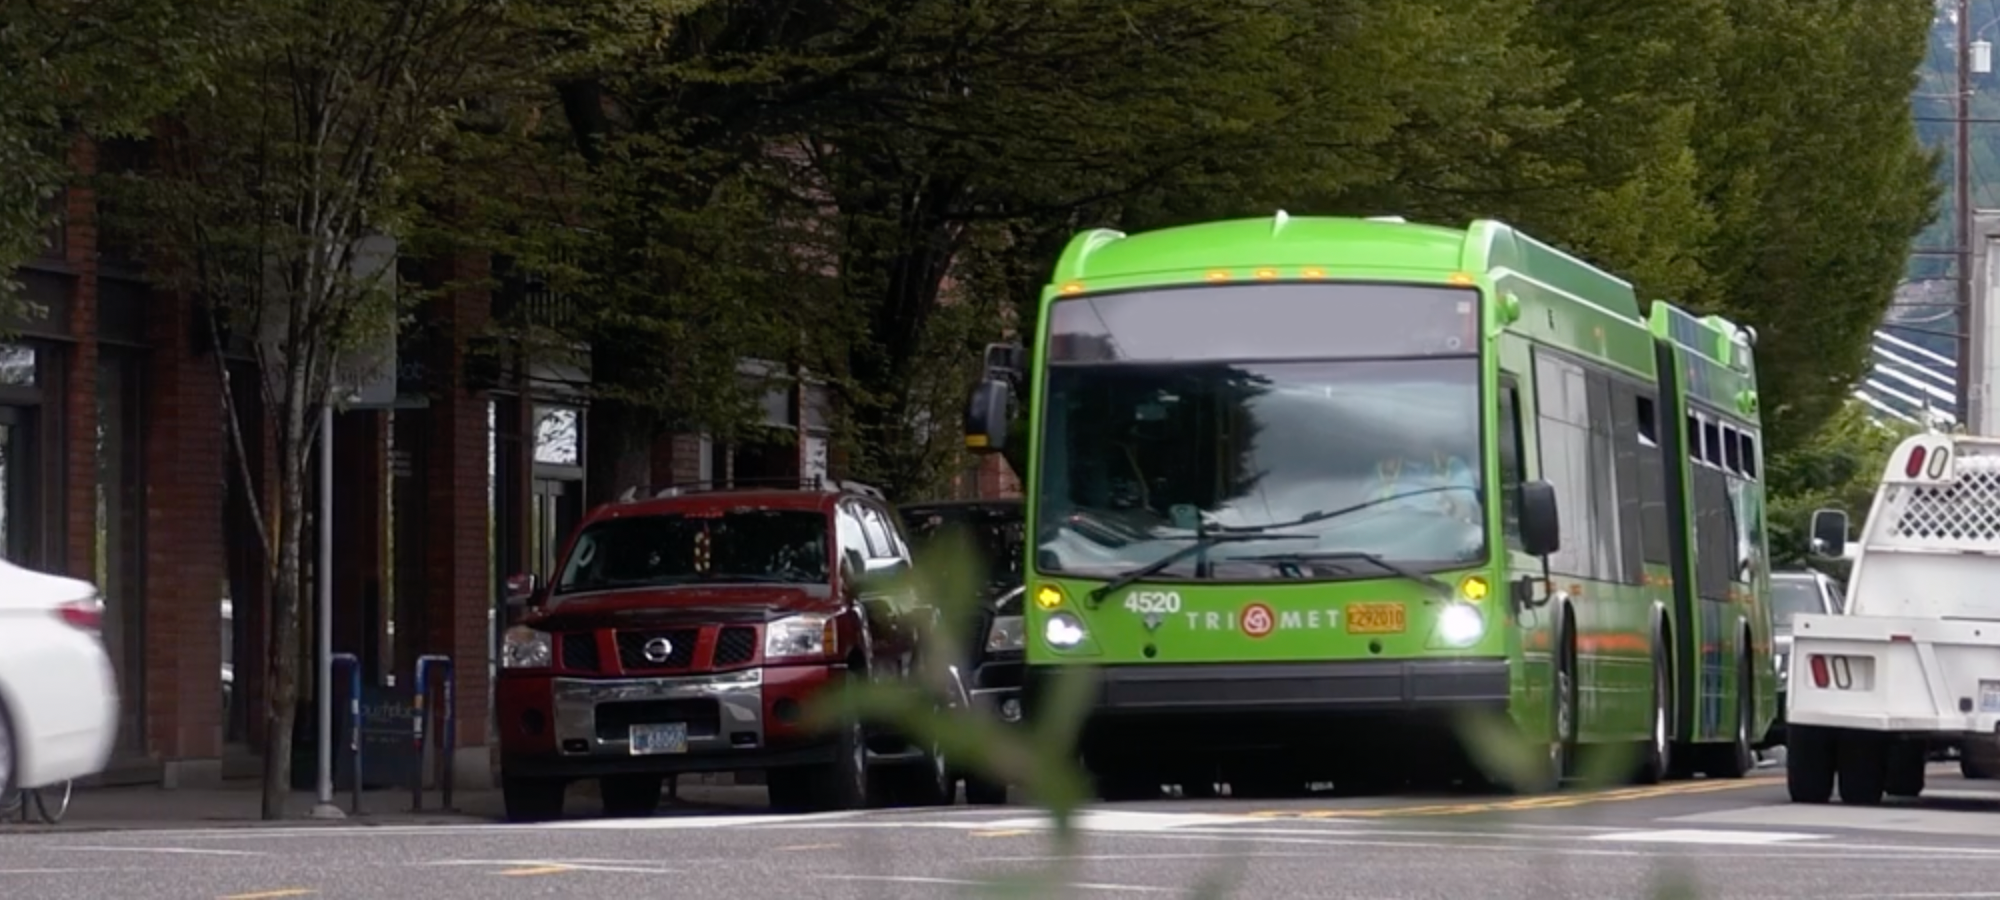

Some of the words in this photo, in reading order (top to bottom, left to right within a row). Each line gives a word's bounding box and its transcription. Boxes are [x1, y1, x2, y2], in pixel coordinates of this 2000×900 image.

[1124, 591, 1181, 614] 4520
[1185, 611, 1236, 631] TRI
[1279, 609, 1340, 630] MET
